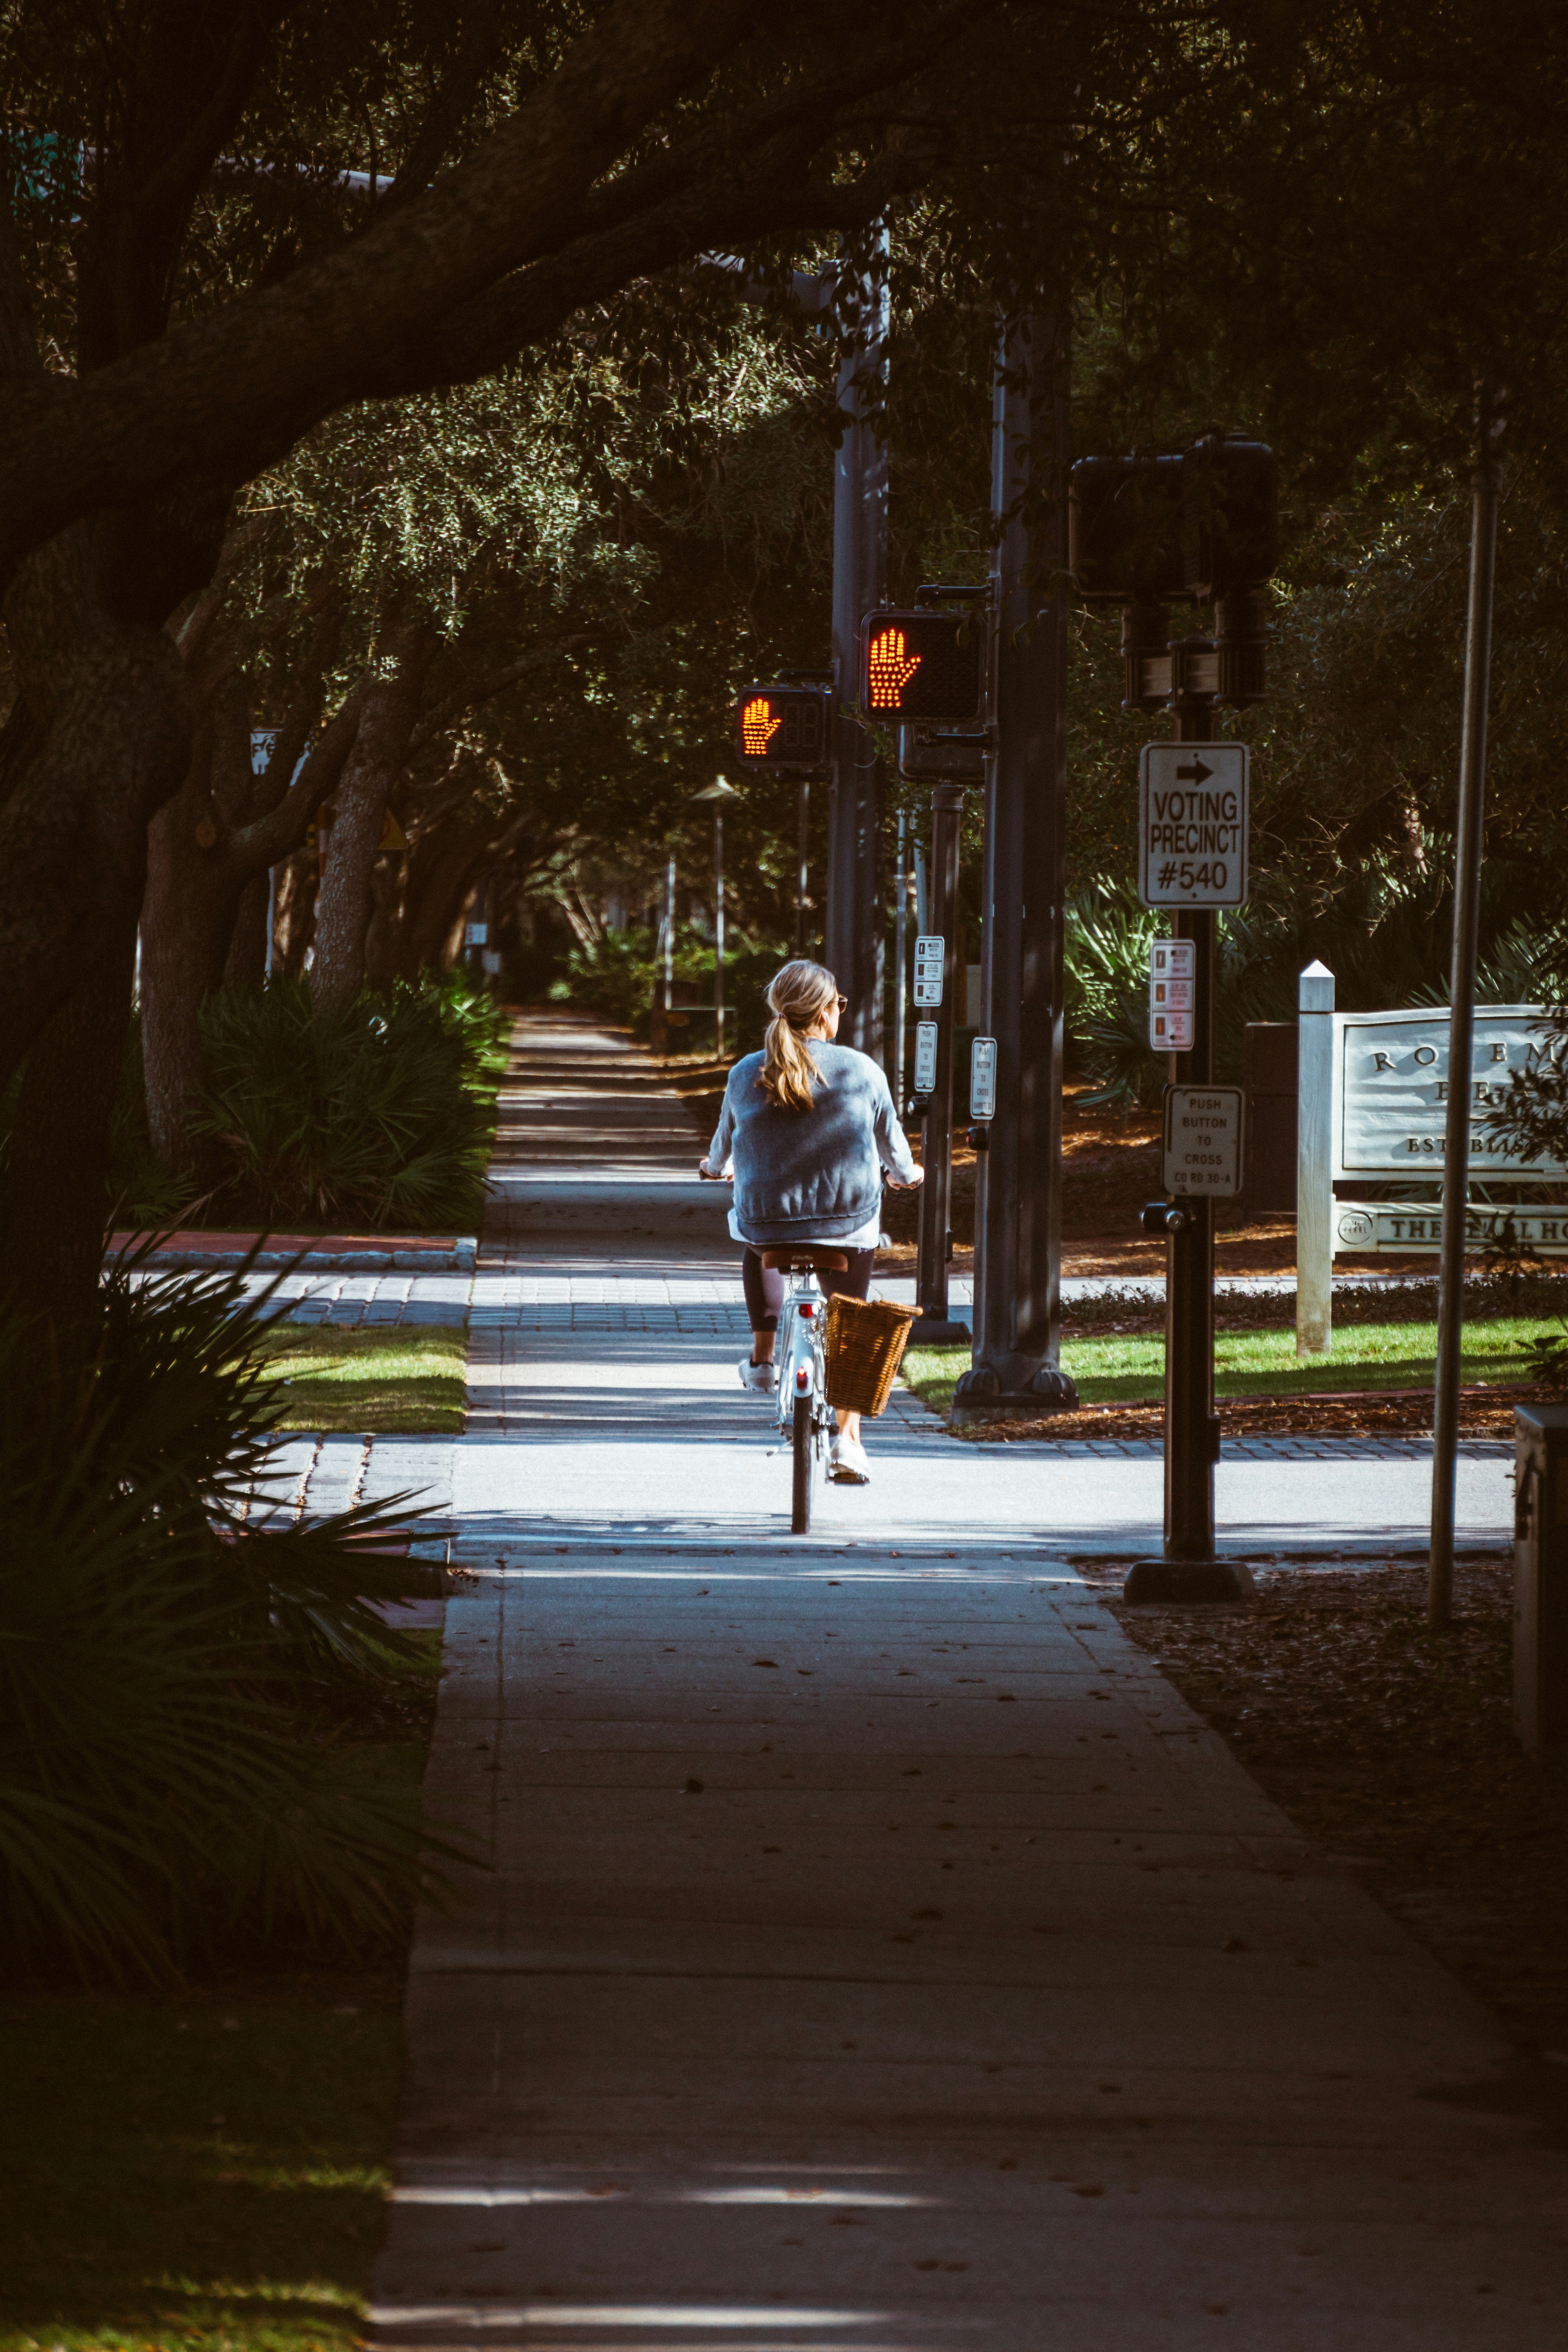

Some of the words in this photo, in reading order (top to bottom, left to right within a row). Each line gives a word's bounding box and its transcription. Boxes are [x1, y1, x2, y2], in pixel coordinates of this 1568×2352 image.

[1154, 791, 1238, 822] VOTING
[1151, 824, 1240, 854] PRECINCT
[1158, 862, 1228, 891] #540
[1190, 1099, 1221, 1110] PUSH
[1183, 1117, 1227, 1128] BUTTON
[1197, 1135, 1211, 1146] TO
[1185, 1154, 1223, 1165] CROSS
[1175, 1172, 1187, 1182] CO
[1191, 1173, 1203, 1183] RD
[1207, 1174, 1231, 1183] 30-A
[1391, 1220, 1442, 1238] THE
